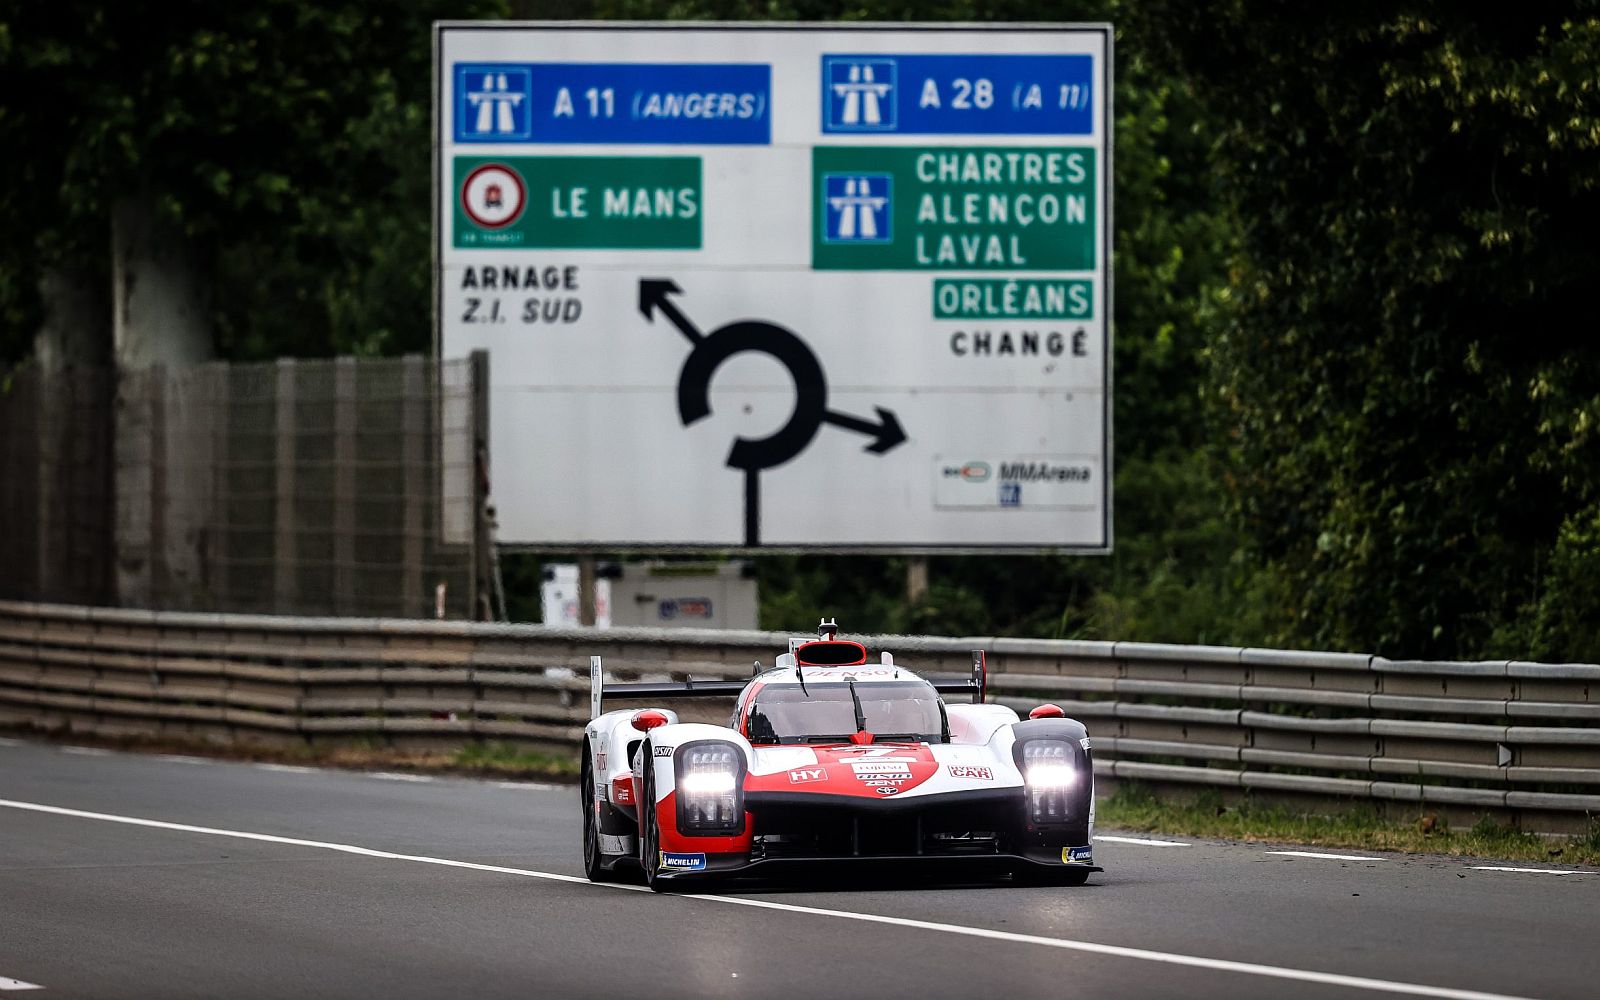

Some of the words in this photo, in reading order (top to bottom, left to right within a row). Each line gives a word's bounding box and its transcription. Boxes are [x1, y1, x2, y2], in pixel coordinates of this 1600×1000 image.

[553, 87, 574, 118] A
[585, 87, 615, 118] 11
[631, 90, 766, 121] (ANGERS)
[920, 78, 941, 109] A
[951, 78, 994, 110] 28
[1012, 82, 1042, 111] (A
[1059, 82, 1089, 111] 11)
[916, 153, 1086, 184] CHARTRES
[552, 187, 588, 218] LE
[603, 187, 698, 218] MANS
[917, 194, 1087, 227] ALENÇON
[916, 234, 1026, 265] LAVAL
[461, 265, 579, 291] ARNAGE
[461, 298, 506, 324] Z.I.
[522, 298, 583, 324] SUD
[938, 279, 1089, 316] ORLÉANS
[950, 327, 1088, 357] CHANGÉ
[805, 670, 889, 678] DENSO
[790, 769, 822, 781] HY
[864, 779, 905, 787] ZENT
[953, 770, 990, 779] CAR
[667, 858, 700, 866] MICHELIN
